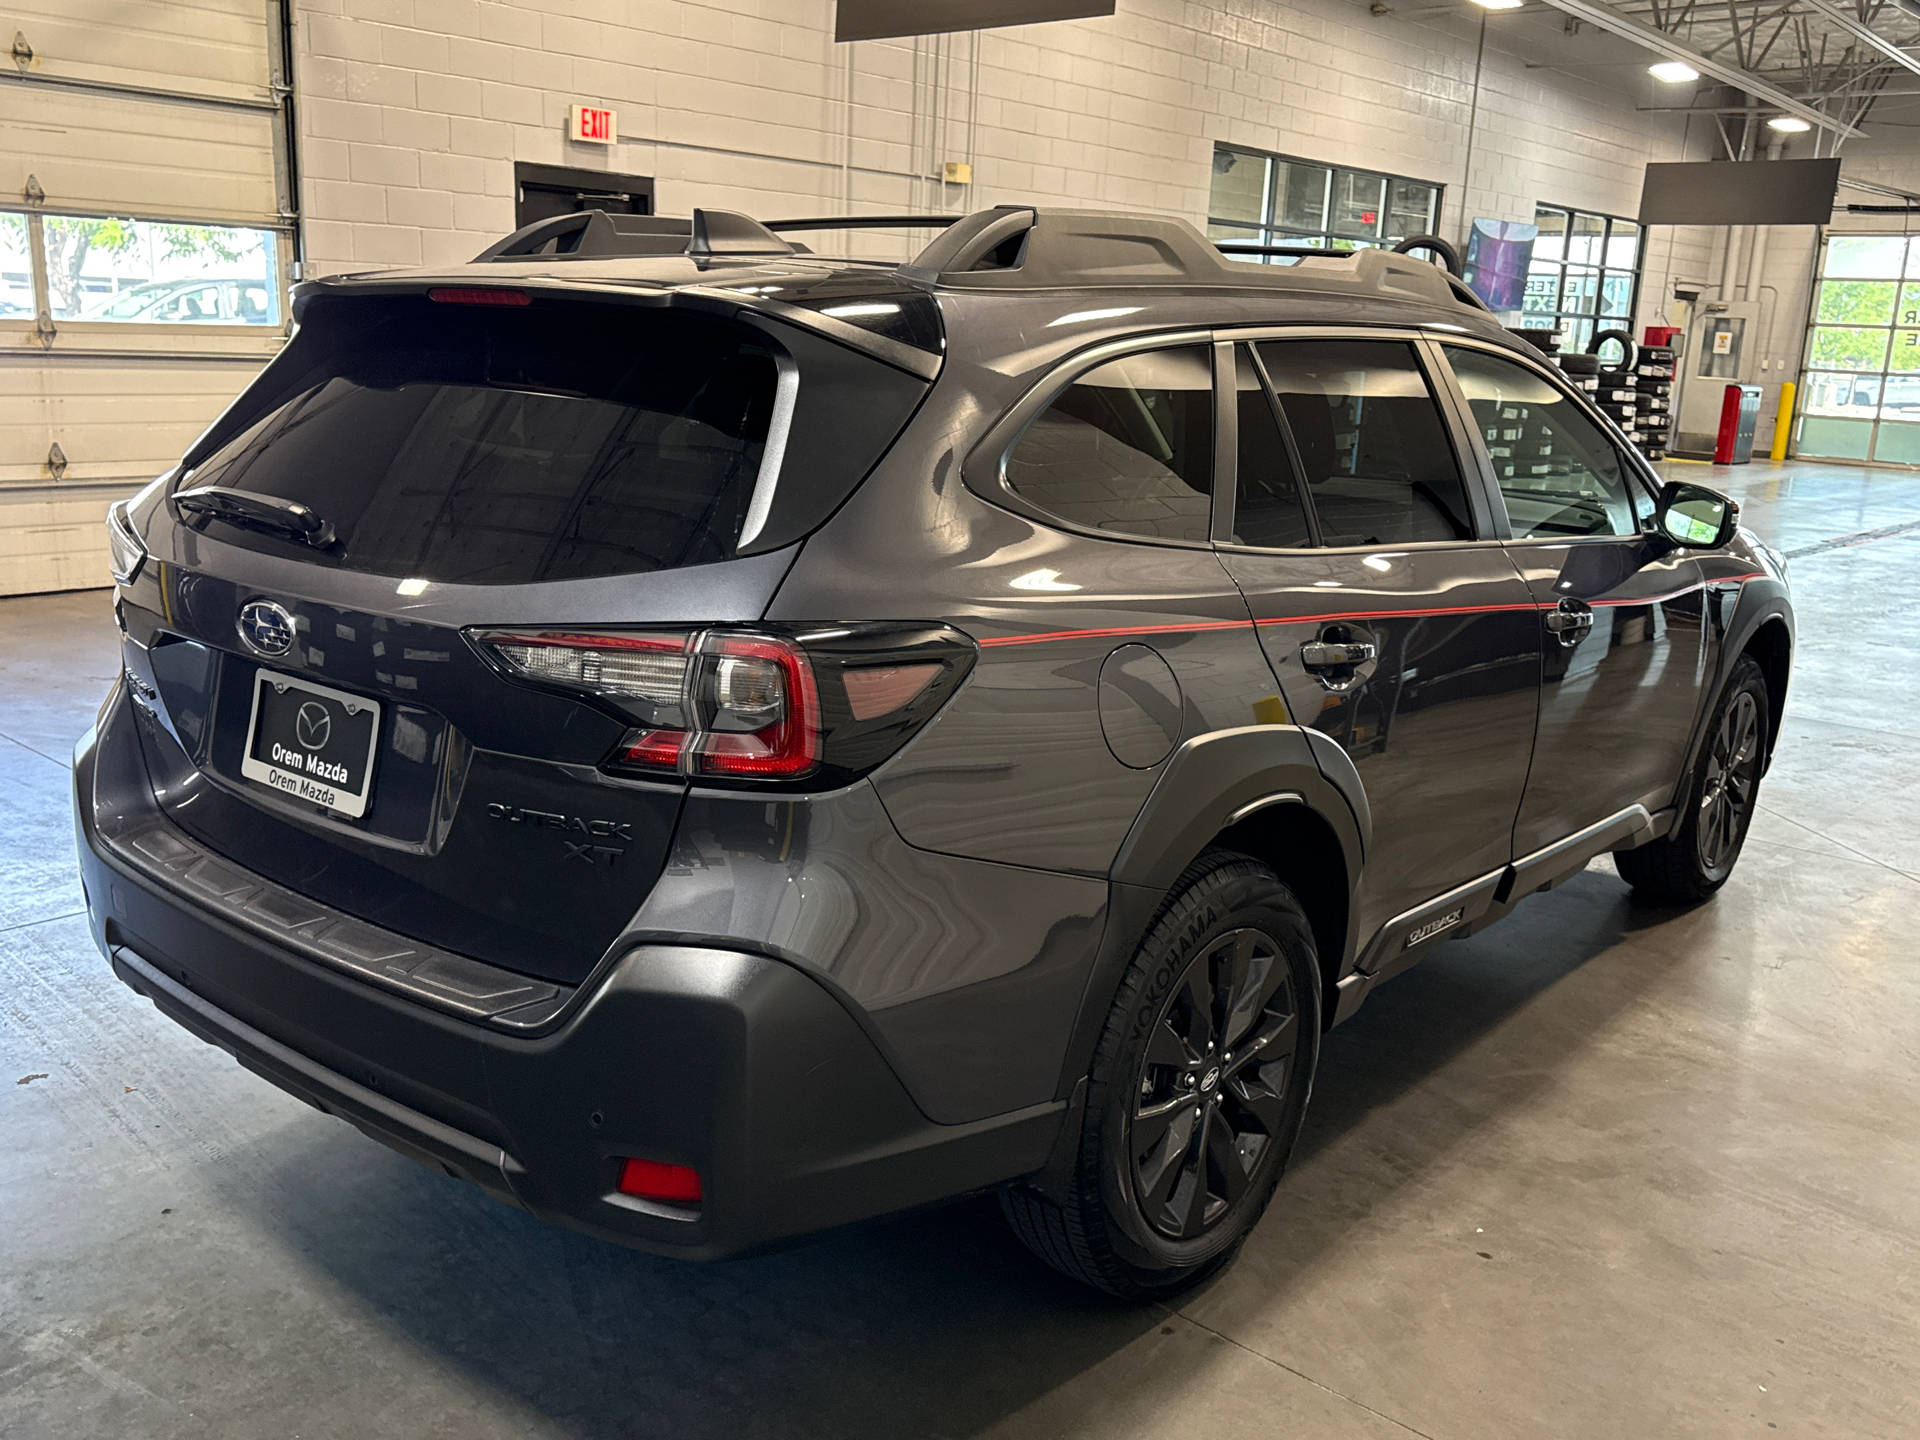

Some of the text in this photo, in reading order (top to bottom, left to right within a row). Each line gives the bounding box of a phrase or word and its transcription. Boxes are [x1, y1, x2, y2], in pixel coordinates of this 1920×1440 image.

[581, 107, 611, 140] EXIT
[271, 742, 348, 784] Orem Mazda
[269, 769, 335, 805] Orem Mazda
[486, 802, 633, 841] OUTBACK
[562, 840, 625, 866] XT
[1409, 909, 1462, 942] OUTBACK
[1128, 906, 1218, 1042] YOKOHAMA
